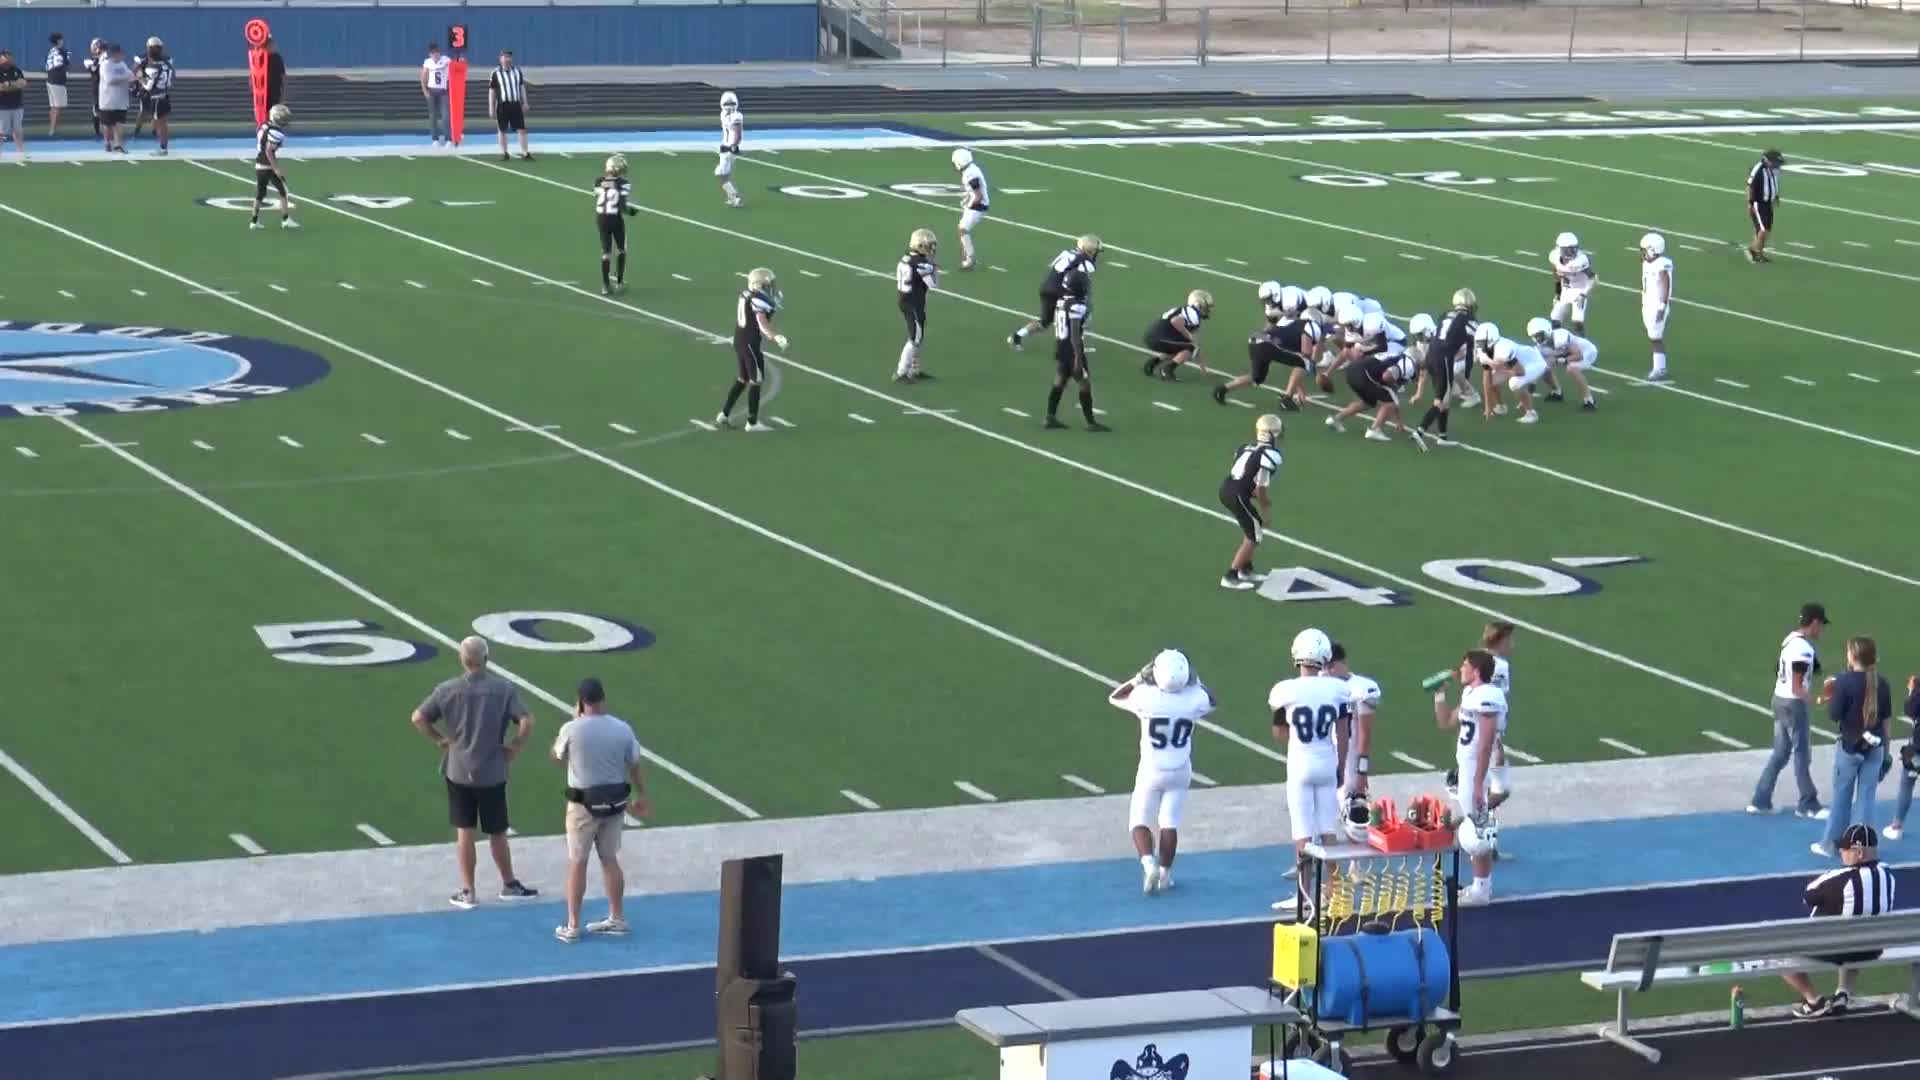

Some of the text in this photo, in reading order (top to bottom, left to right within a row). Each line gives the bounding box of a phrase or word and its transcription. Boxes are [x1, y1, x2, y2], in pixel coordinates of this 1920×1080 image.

[451, 26, 465, 48] 3
[434, 71, 442, 85] 6
[1300, 171, 1497, 187] 20
[1256, 558, 1588, 606] 40
[253, 610, 648, 666] 50
[1149, 717, 1193, 749] 50
